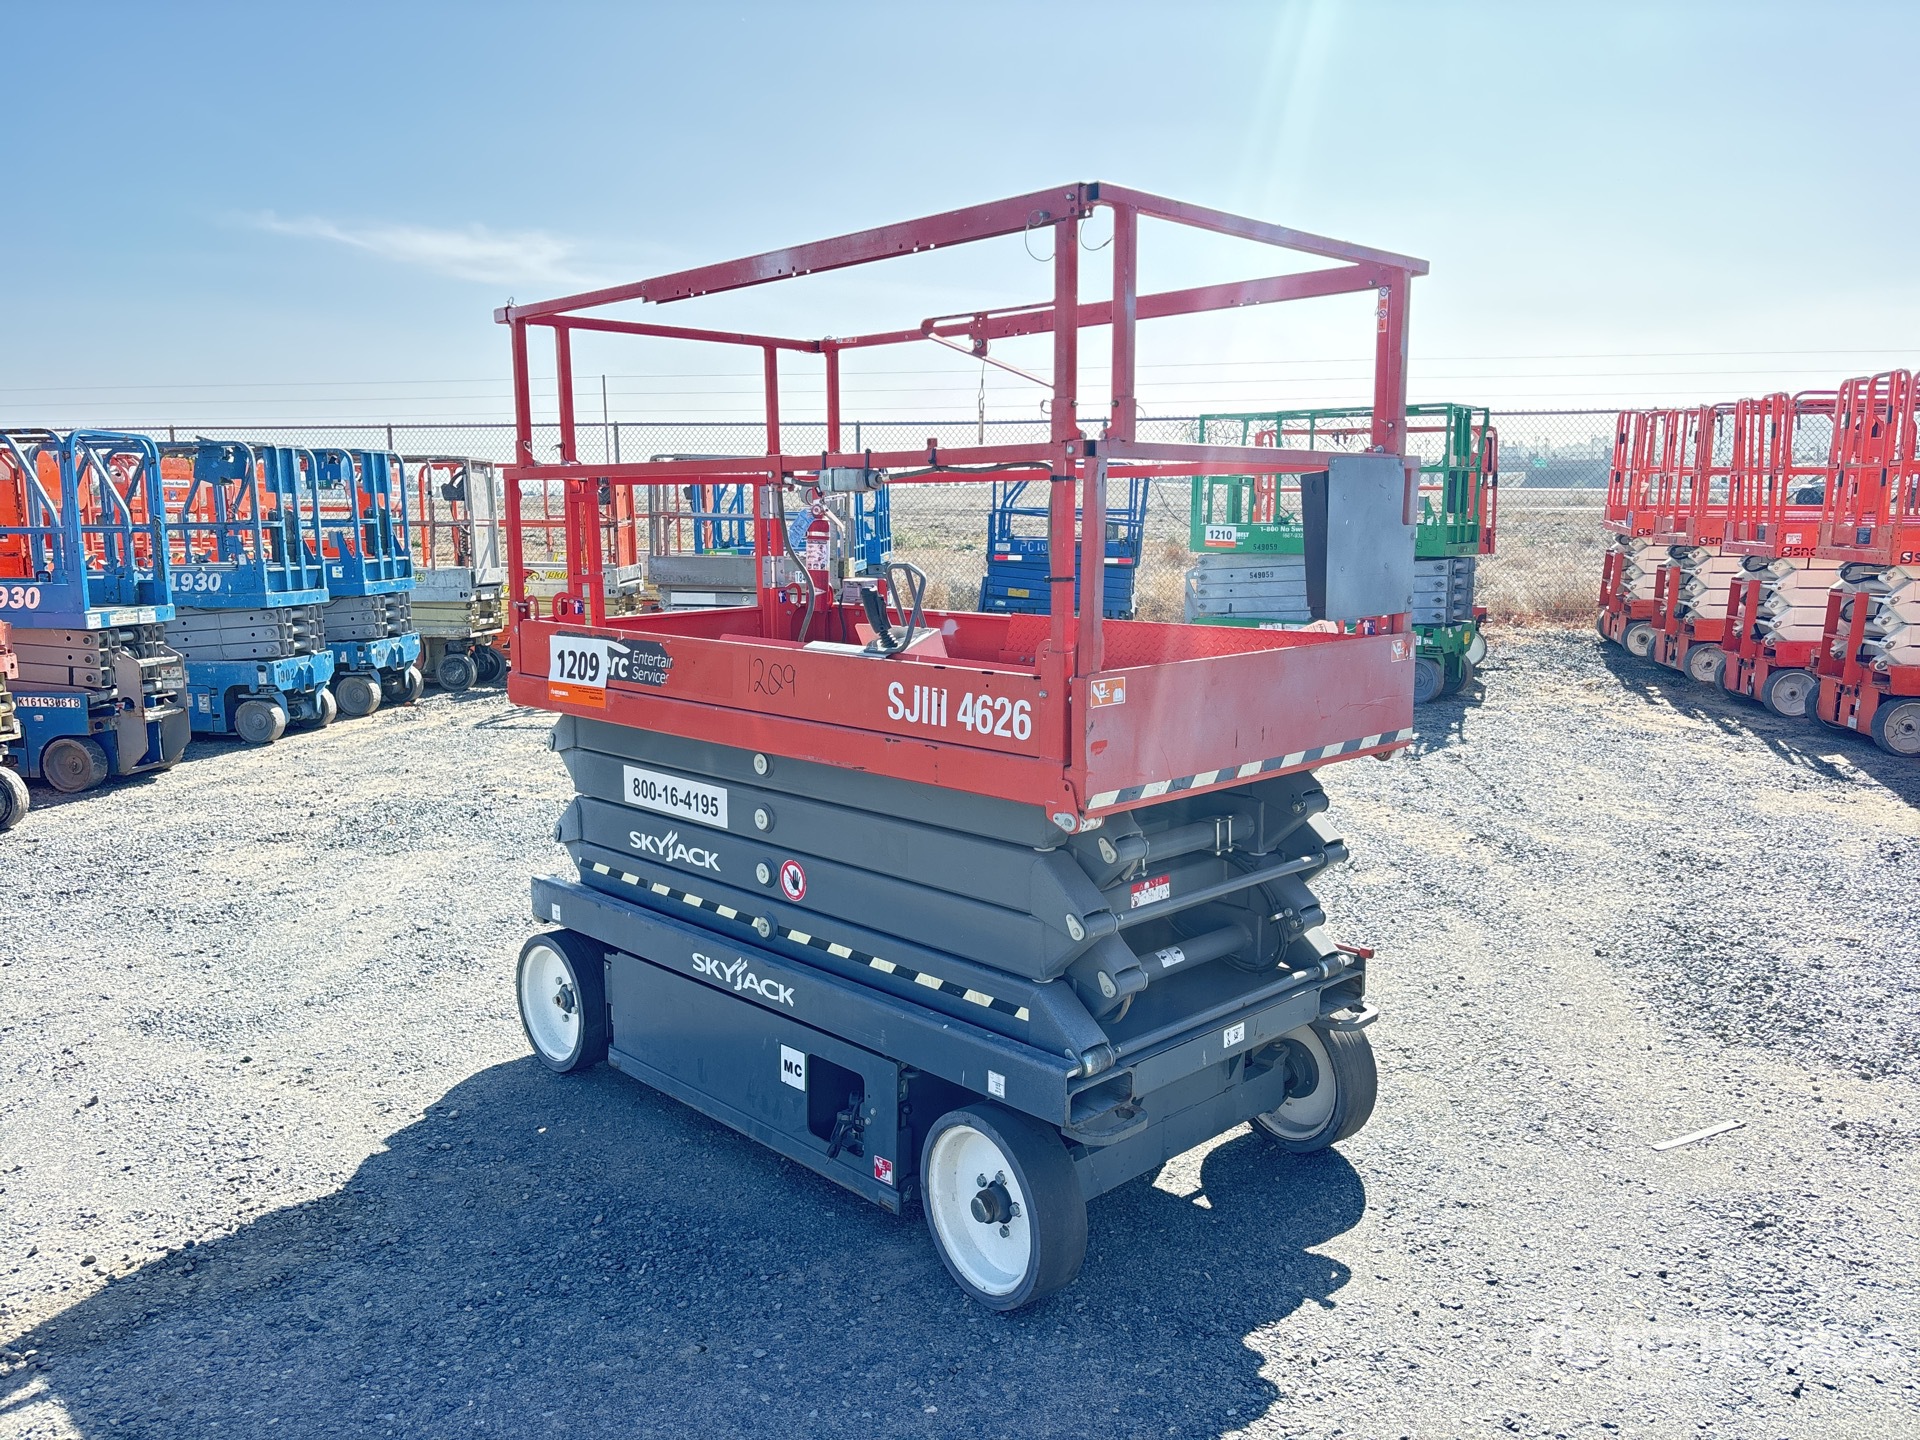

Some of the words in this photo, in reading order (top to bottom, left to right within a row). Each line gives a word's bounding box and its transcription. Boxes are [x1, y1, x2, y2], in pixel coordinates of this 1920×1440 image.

[1209, 530, 1232, 540] 1210
[1253, 543, 1278, 551] 549059
[169, 572, 222, 592] 1930
[1249, 571, 1274, 579] 549059
[0, 586, 41, 610] 930
[557, 649, 600, 682] 1209
[607, 655, 629, 678] rc
[956, 692, 1032, 740] 4626
[633, 777, 719, 818] 800-16-4195
[629, 830, 721, 872] SKYJACK
[692, 952, 795, 1007] SKYJACK
[783, 1058, 803, 1078] MC
